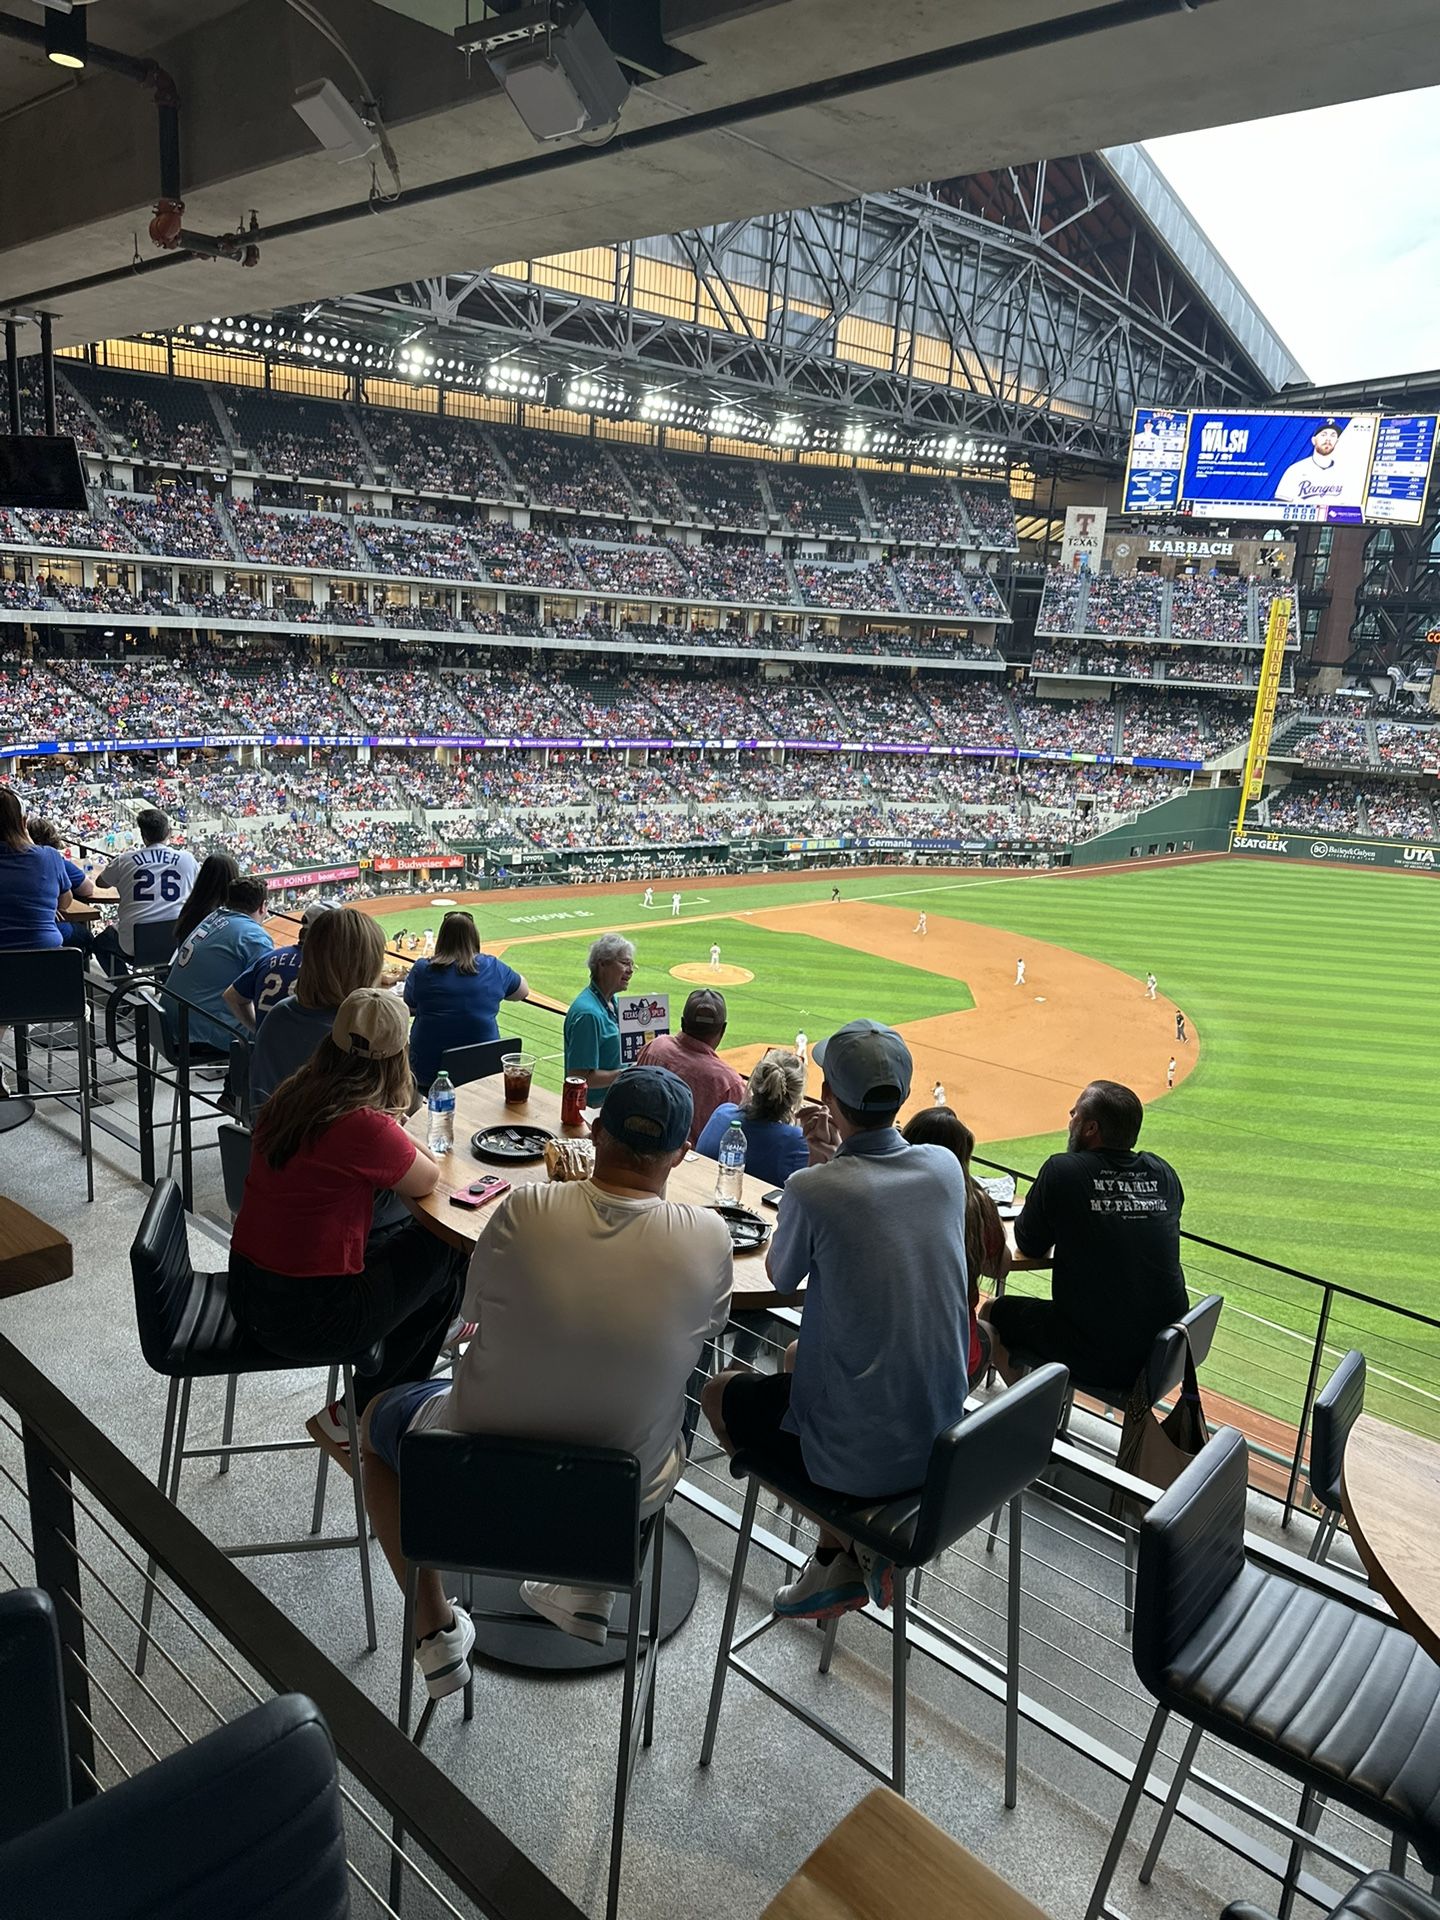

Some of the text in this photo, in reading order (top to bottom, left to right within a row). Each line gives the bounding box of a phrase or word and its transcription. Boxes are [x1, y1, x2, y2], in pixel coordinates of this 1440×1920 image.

[1201, 429, 1249, 453] WALSH
[1148, 540, 1234, 556] KARBACH
[1272, 617, 1285, 672] BRING
[1260, 713, 1270, 755] HEAT
[868, 838, 912, 848] Germania
[1233, 837, 1288, 853] SEATGEEK
[132, 850, 180, 866] OLIVER
[1403, 848, 1435, 863] UTA
[397, 859, 444, 870] Budweiser
[133, 869, 181, 902] 26
[266, 879, 281, 888] UEL
[284, 874, 312, 885] POINTS
[178, 927, 209, 967] 5
[1093, 1179, 1158, 1193] MY FAMILY
[1090, 1199, 1111, 1211] MY
